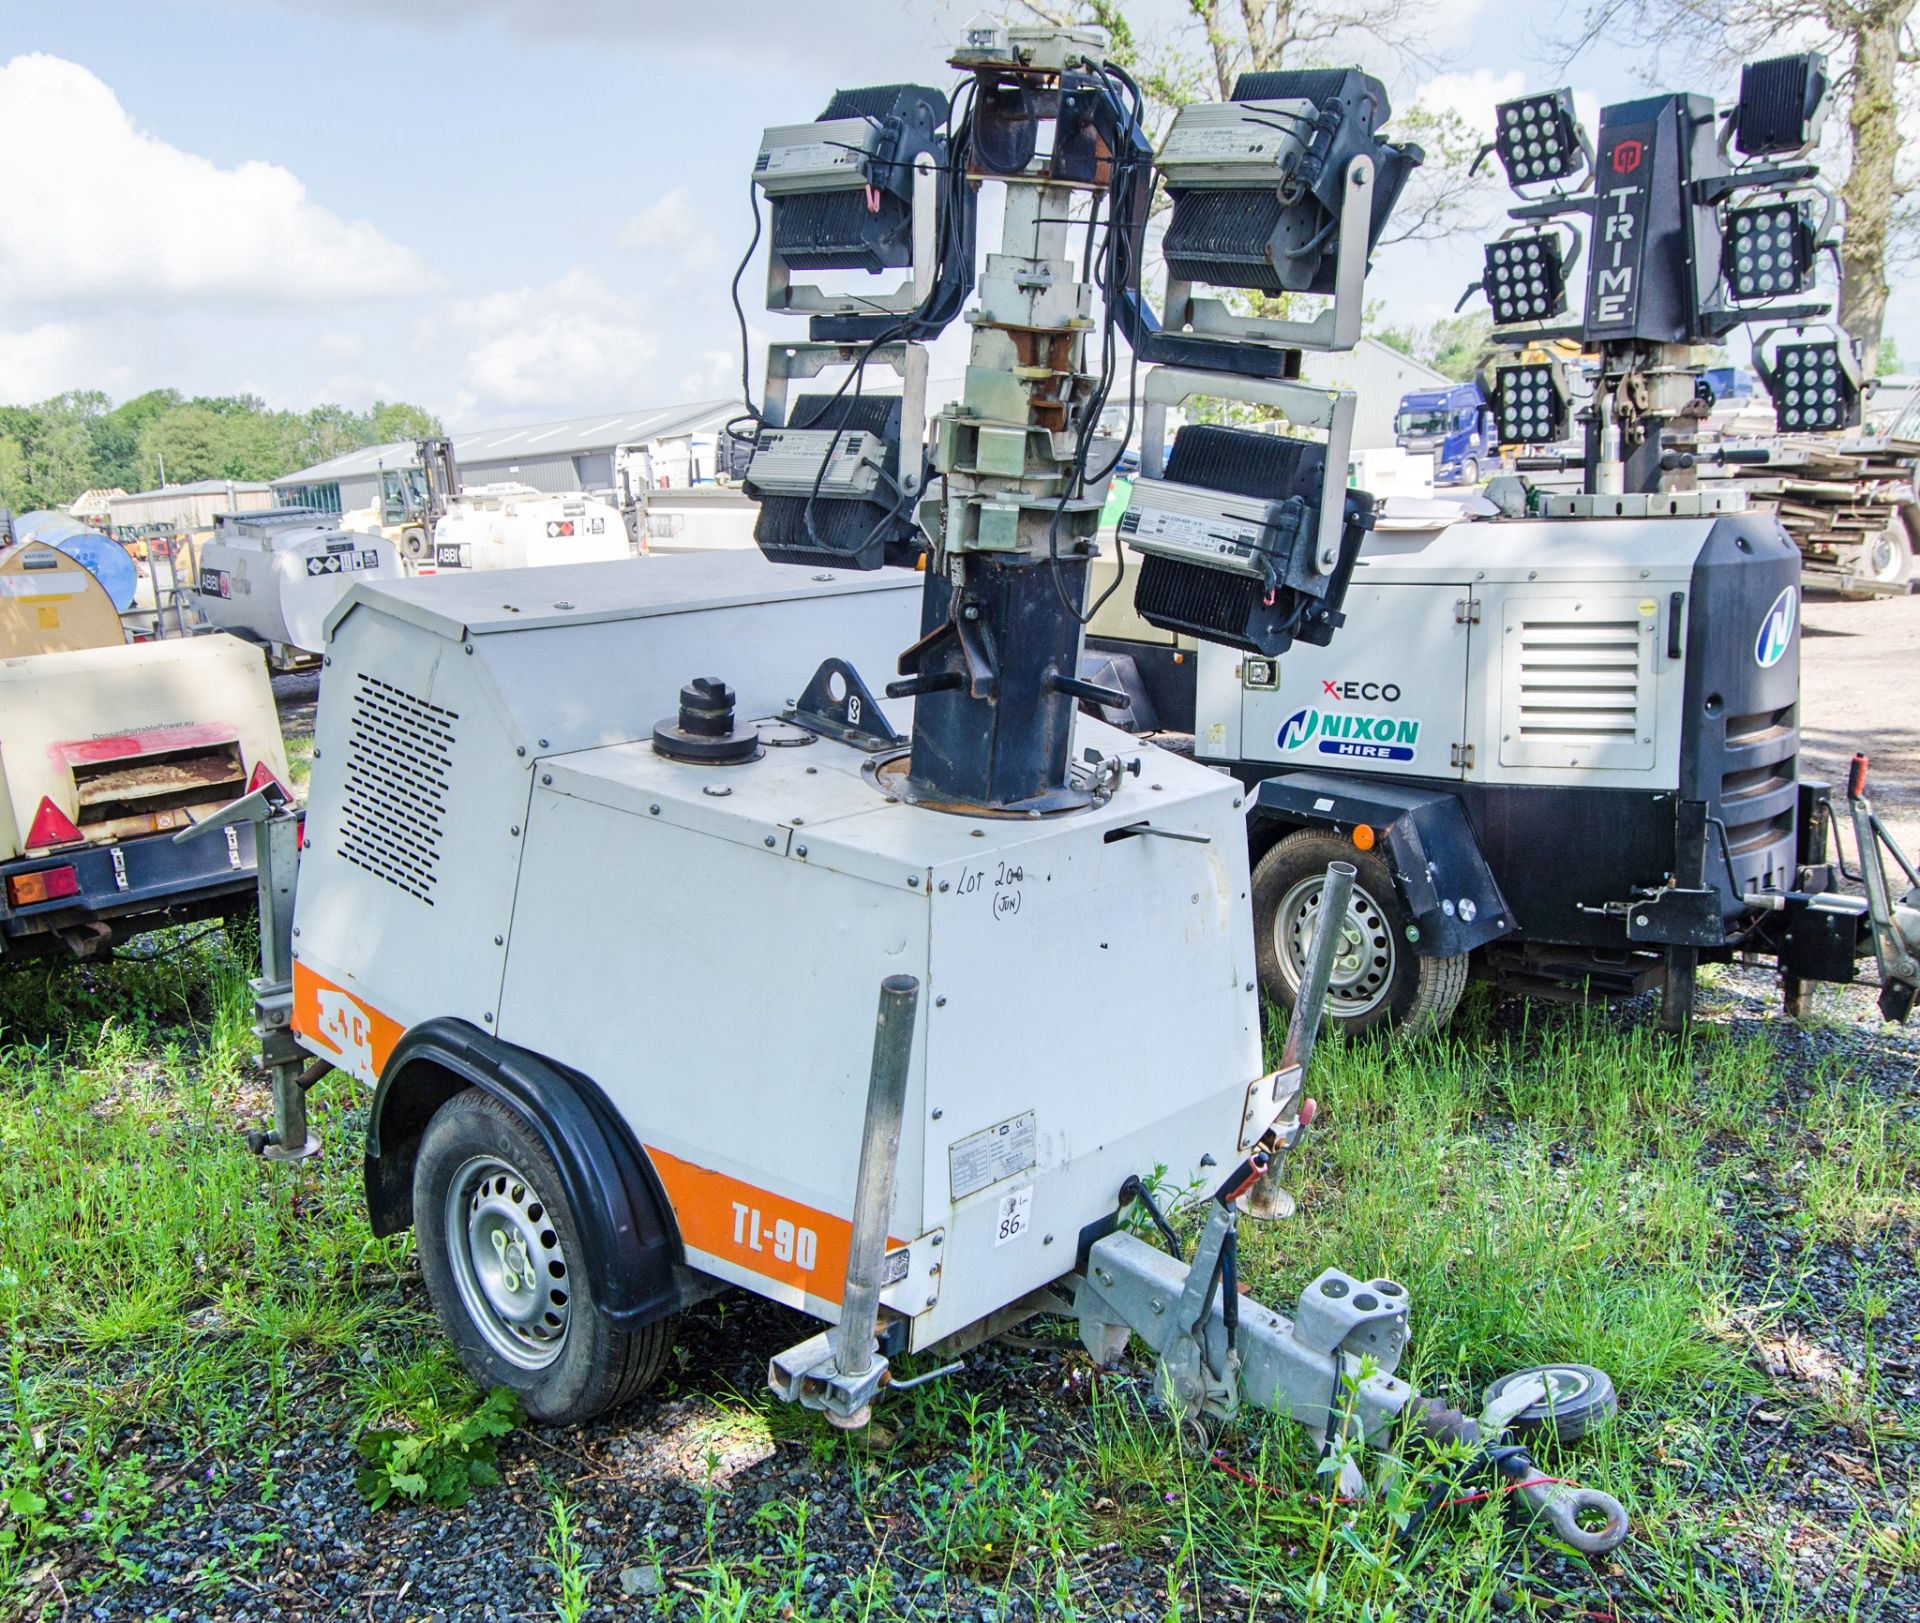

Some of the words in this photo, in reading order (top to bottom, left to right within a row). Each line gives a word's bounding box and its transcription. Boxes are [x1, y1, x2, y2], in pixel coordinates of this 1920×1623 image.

[1597, 185, 1639, 323] TRIME
[1321, 680, 1401, 702] X-ECO
[1320, 714, 1419, 745] NIXON
[1338, 743, 1392, 758] HIRE
[956, 865, 985, 896] LOT
[731, 1200, 818, 1272] TL-90
[999, 1214, 1021, 1240] 86
